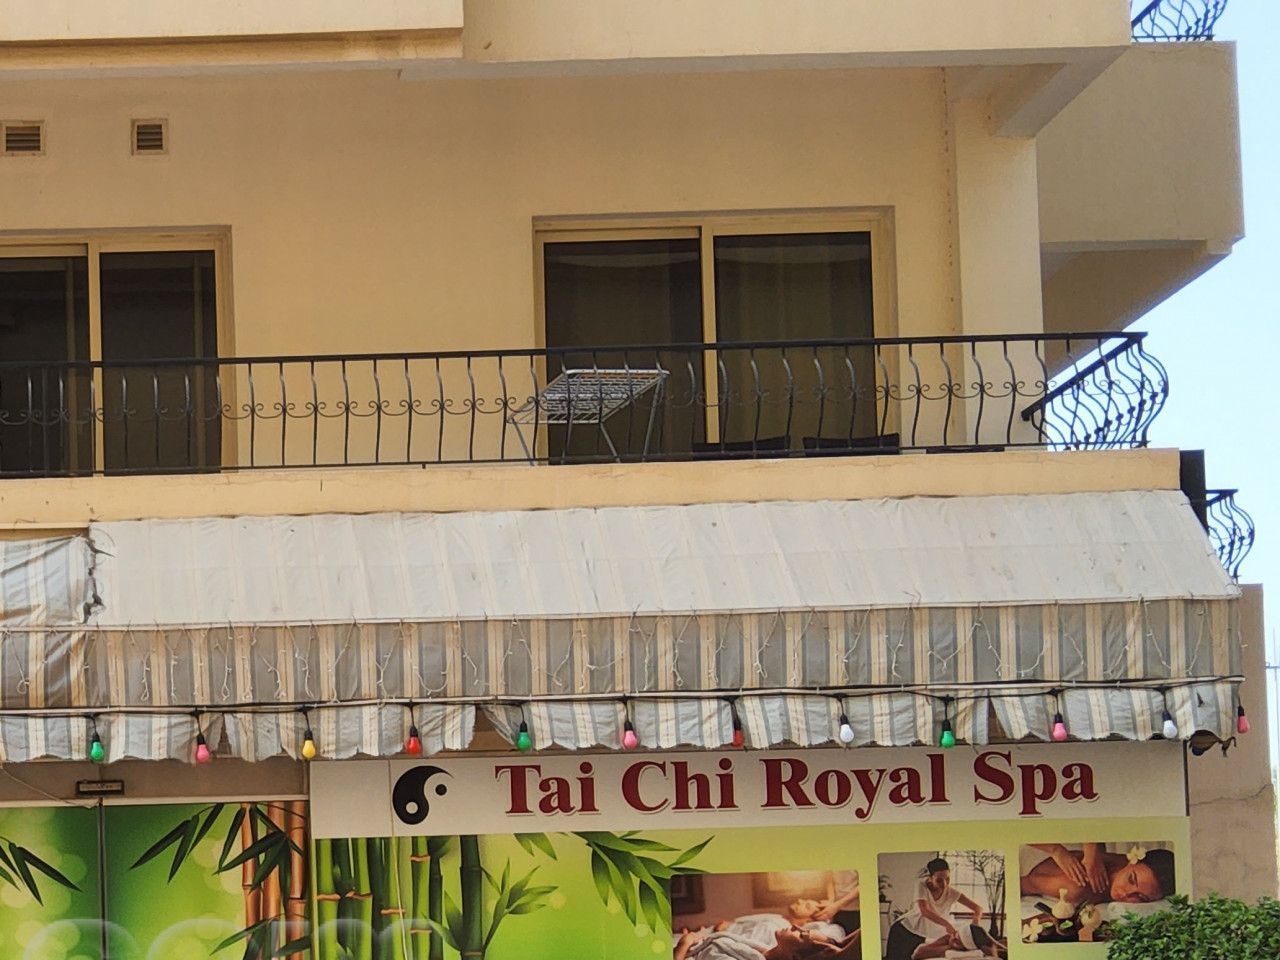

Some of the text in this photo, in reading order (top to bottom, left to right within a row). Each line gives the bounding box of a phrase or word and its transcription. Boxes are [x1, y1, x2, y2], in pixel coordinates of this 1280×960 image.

[494, 750, 1098, 819] Tai Chi Royal Spa
